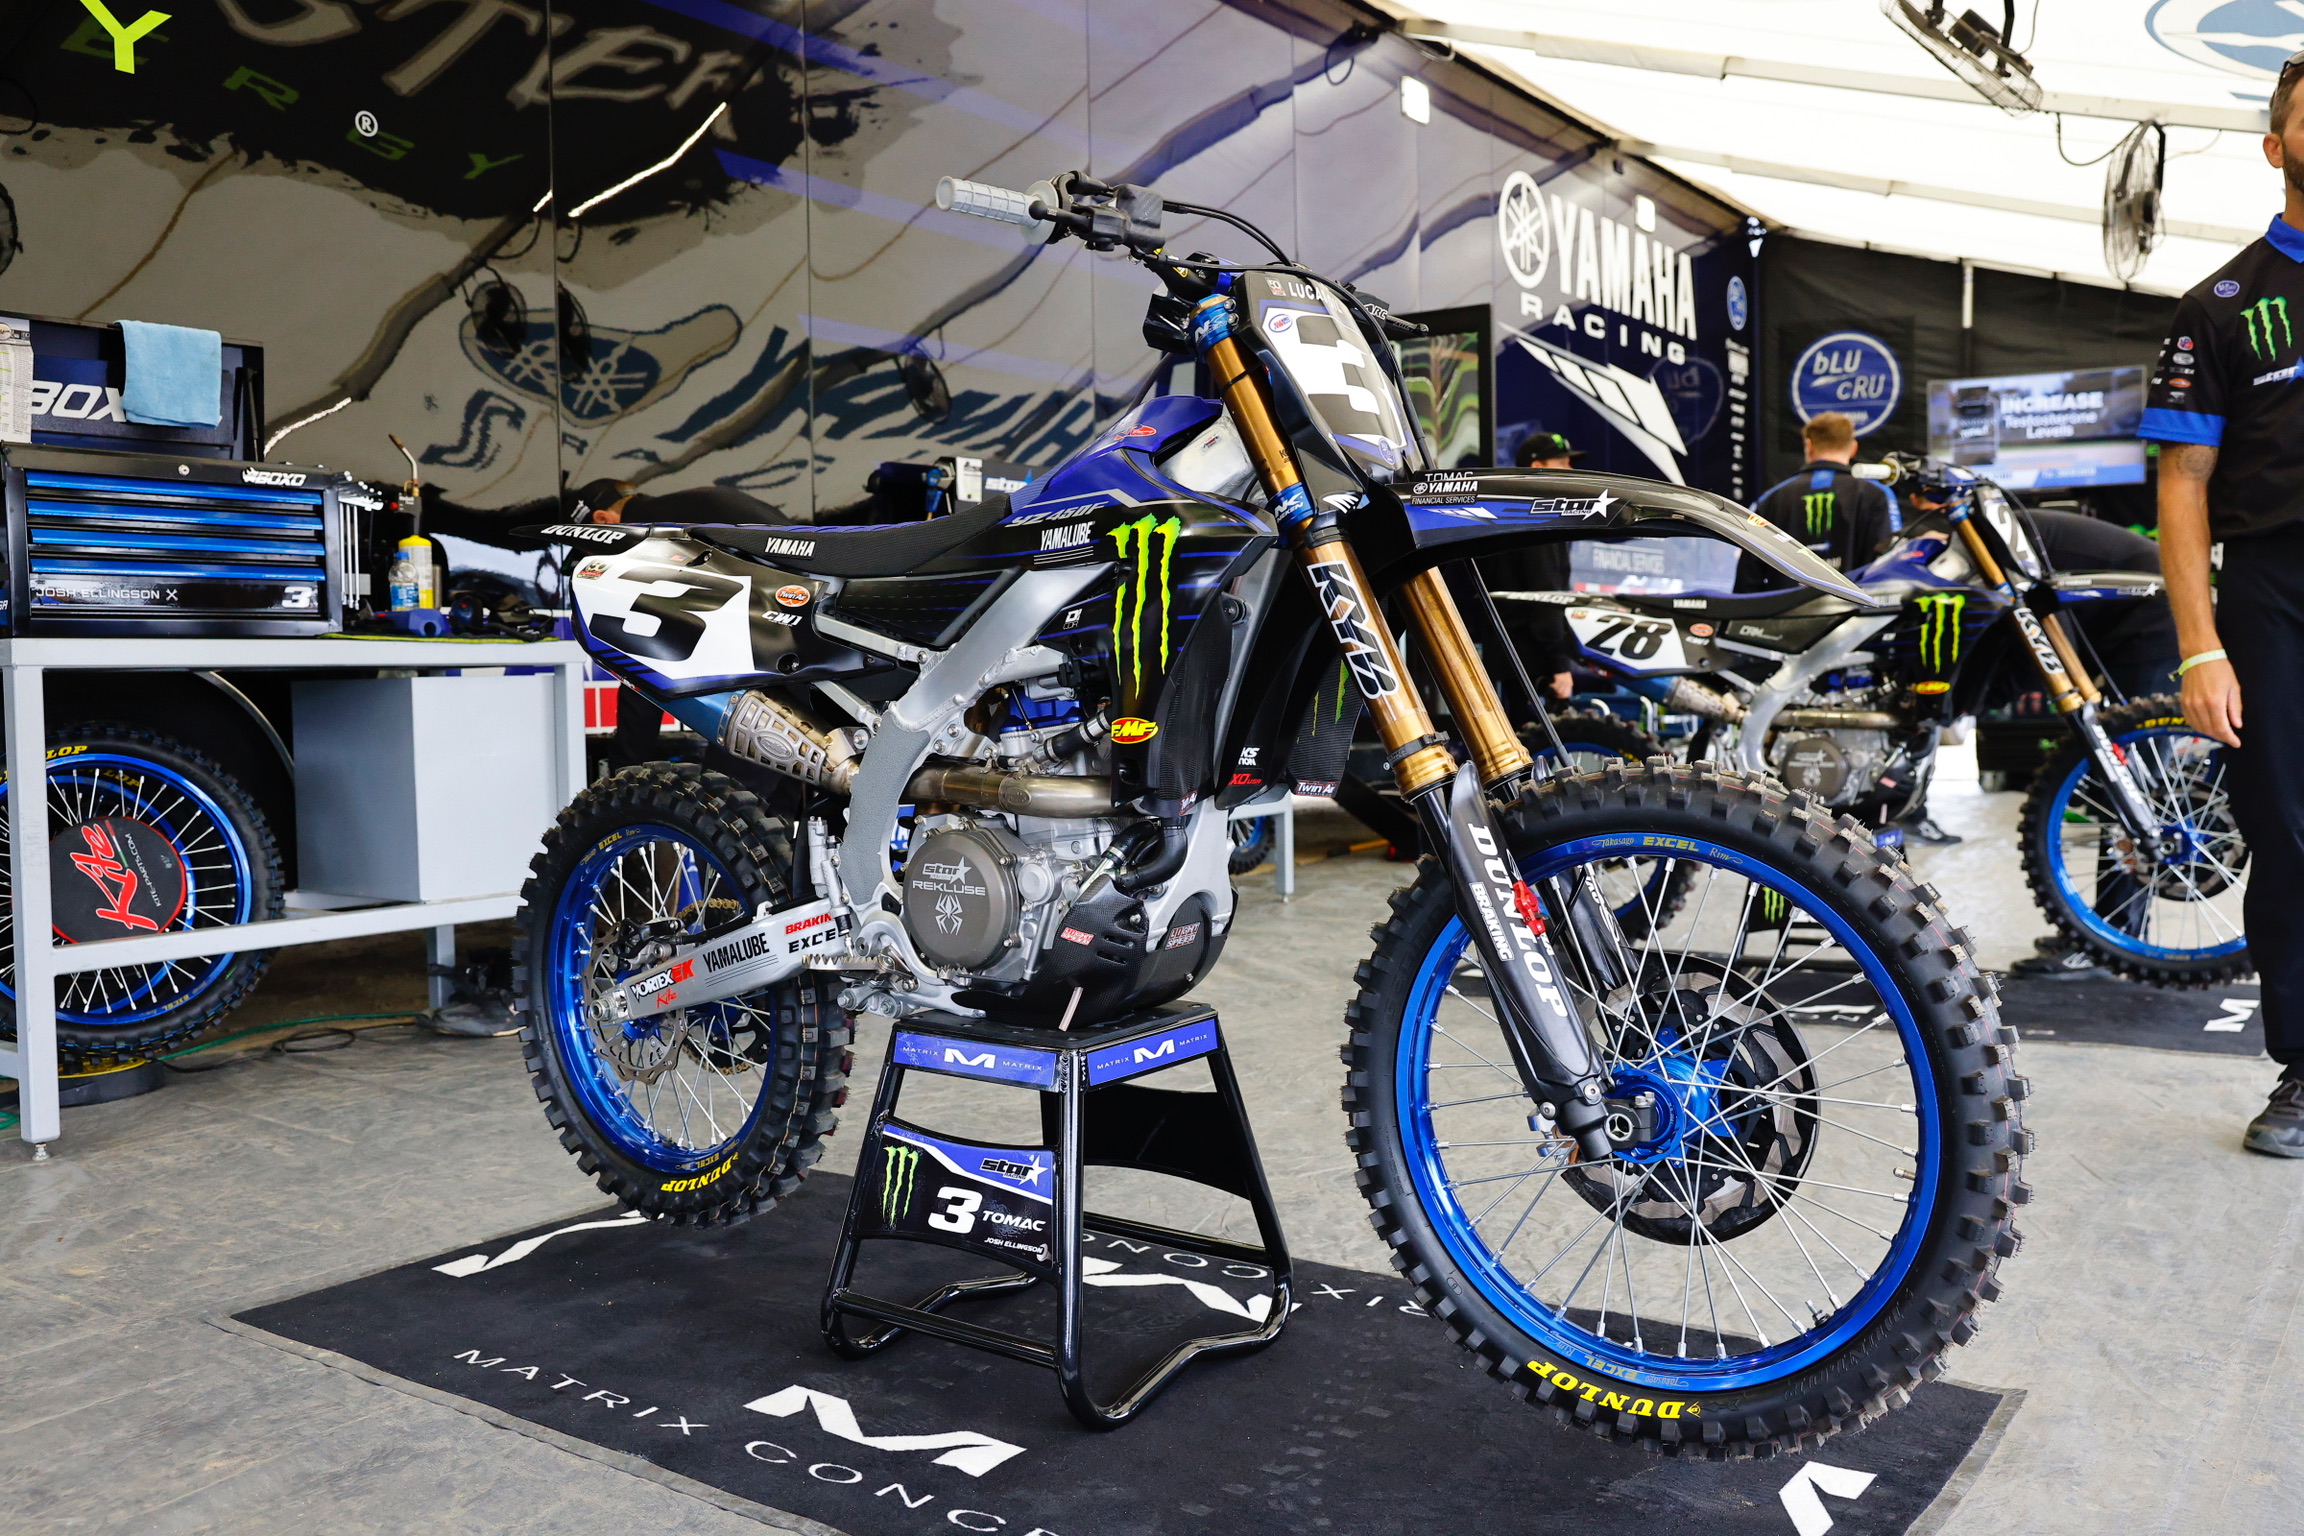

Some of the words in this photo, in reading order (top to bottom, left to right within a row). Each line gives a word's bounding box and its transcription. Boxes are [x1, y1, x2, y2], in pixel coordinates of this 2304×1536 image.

[1551, 193, 1698, 341] YAMAHA
[1521, 291, 1687, 366] RACING
[1296, 314, 1388, 437] 3
[2000, 391, 2104, 413] INCREASE
[254, 470, 306, 487] BOXO
[1427, 481, 1478, 494] YAMAHA
[1411, 495, 1444, 505] FINANCIAL
[1445, 495, 1475, 504] SERVICES
[540, 525, 626, 544] DUNLOP
[764, 537, 816, 557] YAMAHA
[1040, 520, 1095, 551] YAMALUBE
[36, 588, 77, 599] JOSH
[80, 588, 161, 600] ELLINGSON
[281, 586, 313, 608] 3
[589, 566, 745, 662] 3
[1306, 560, 1400, 700] KYB
[1585, 614, 1673, 660] 28
[1111, 720, 1157, 737] FMF
[1298, 781, 1322, 793] Twin
[1643, 836, 1699, 852] EXCEL
[912, 879, 986, 897] REKLUSE
[785, 913, 833, 935] BRAKIN
[1468, 823, 1568, 1017] DUNLOP
[1470, 882, 1514, 962] BRAKING
[703, 932, 769, 973] YAMALUBE
[631, 968, 674, 1000] VORTEX
[903, 1046, 939, 1057] MATRIX
[1002, 1060, 1043, 1072] MATRIX
[1097, 1056, 1130, 1070] MATRIX
[1179, 1033, 1208, 1046] MATRIX
[661, 1160, 732, 1193] DUNLOP
[927, 1186, 983, 1234] 3
[982, 1210, 1046, 1232] TOMAC
[984, 1237, 1003, 1247] JOSH
[1003, 1240, 1043, 1254] ELLINGSON
[1583, 1354, 1638, 1382] EXCEL
[1527, 1360, 1686, 1420] DUNLOP
[453, 1349, 710, 1436] MATRIX
[744, 1439, 1062, 1536] CONC
